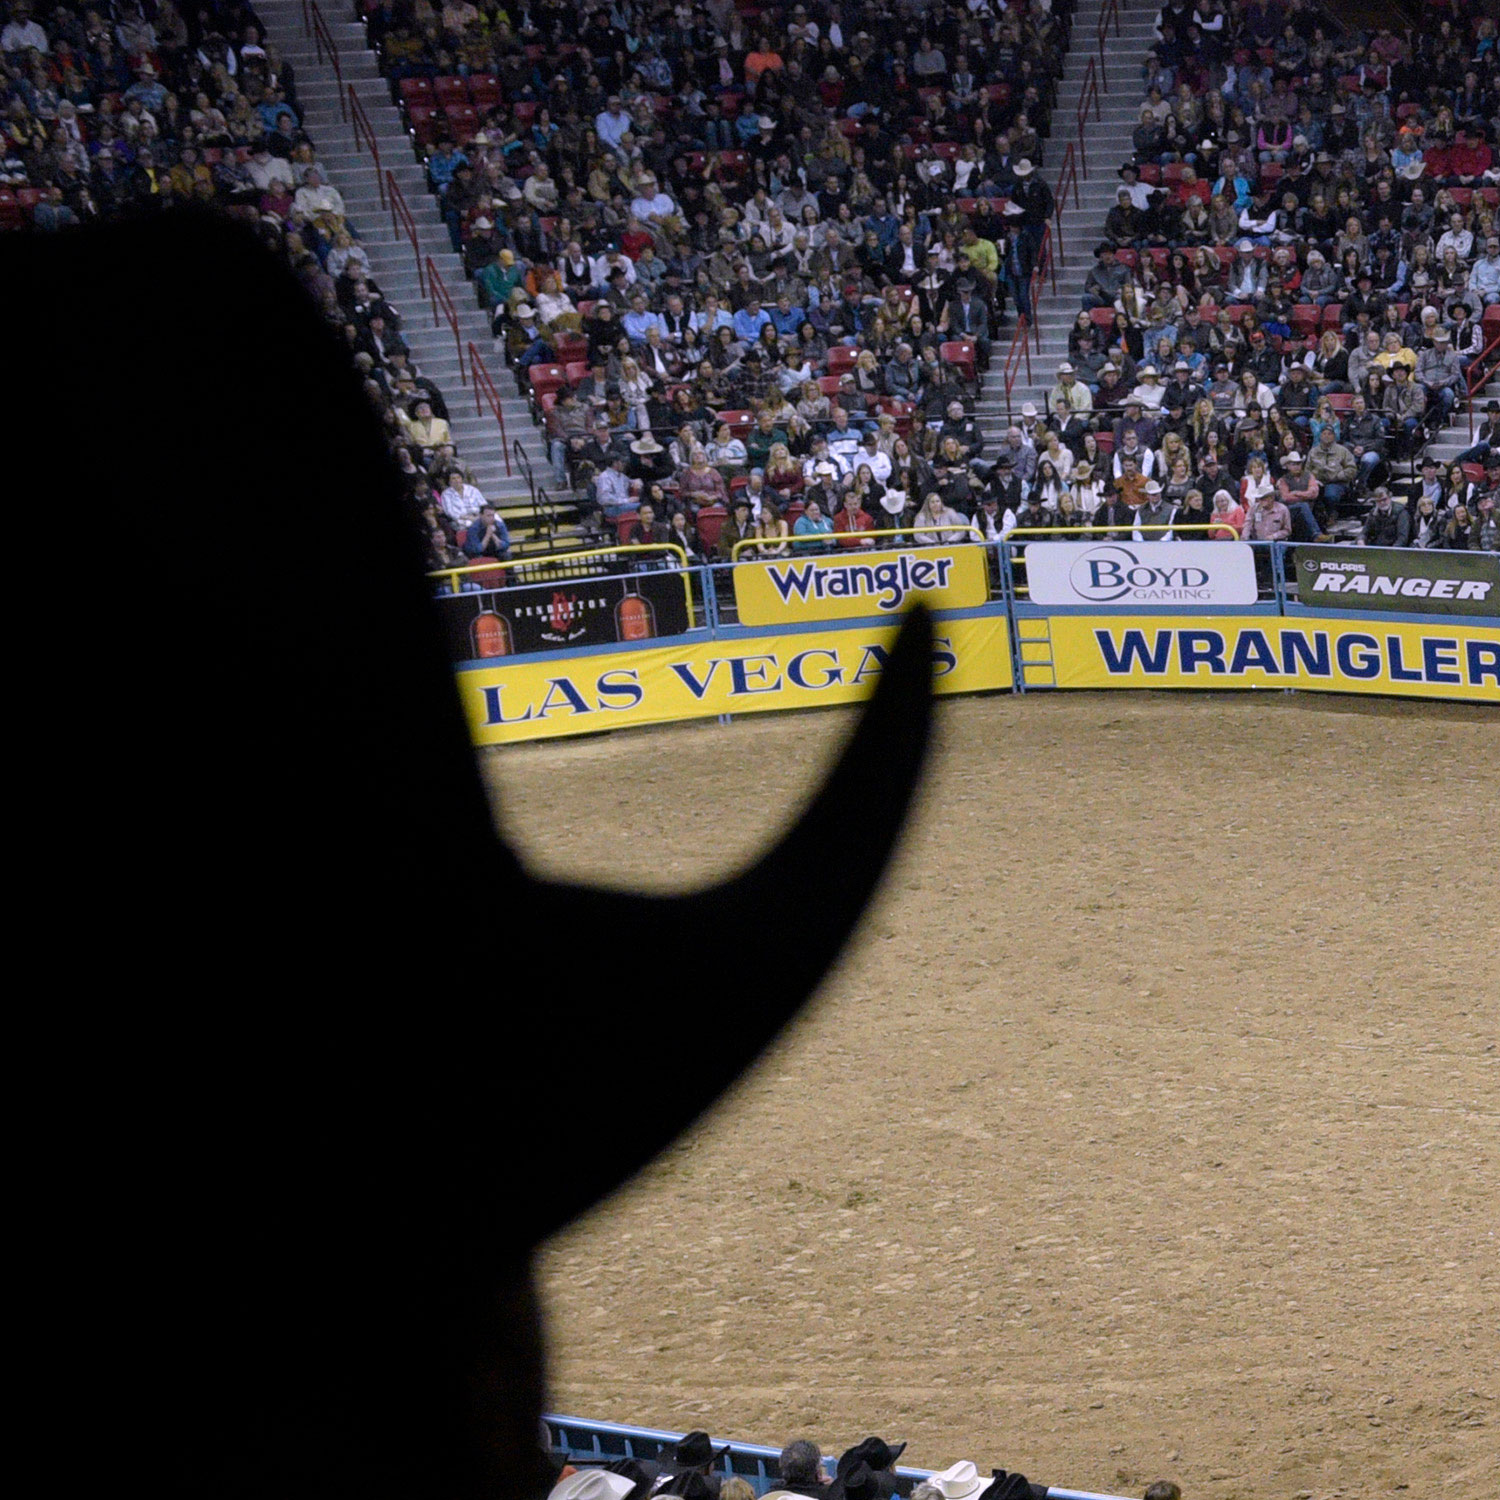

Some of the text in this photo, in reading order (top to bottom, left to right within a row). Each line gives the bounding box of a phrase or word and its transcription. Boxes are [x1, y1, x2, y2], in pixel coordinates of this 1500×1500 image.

[1320, 562, 1366, 573] POLARIS
[767, 554, 952, 610] Wrangler
[1312, 573, 1492, 600] RANGER
[1133, 588, 1211, 600] GAMING
[515, 598, 606, 618] PENDLETON
[479, 669, 643, 726] LAS
